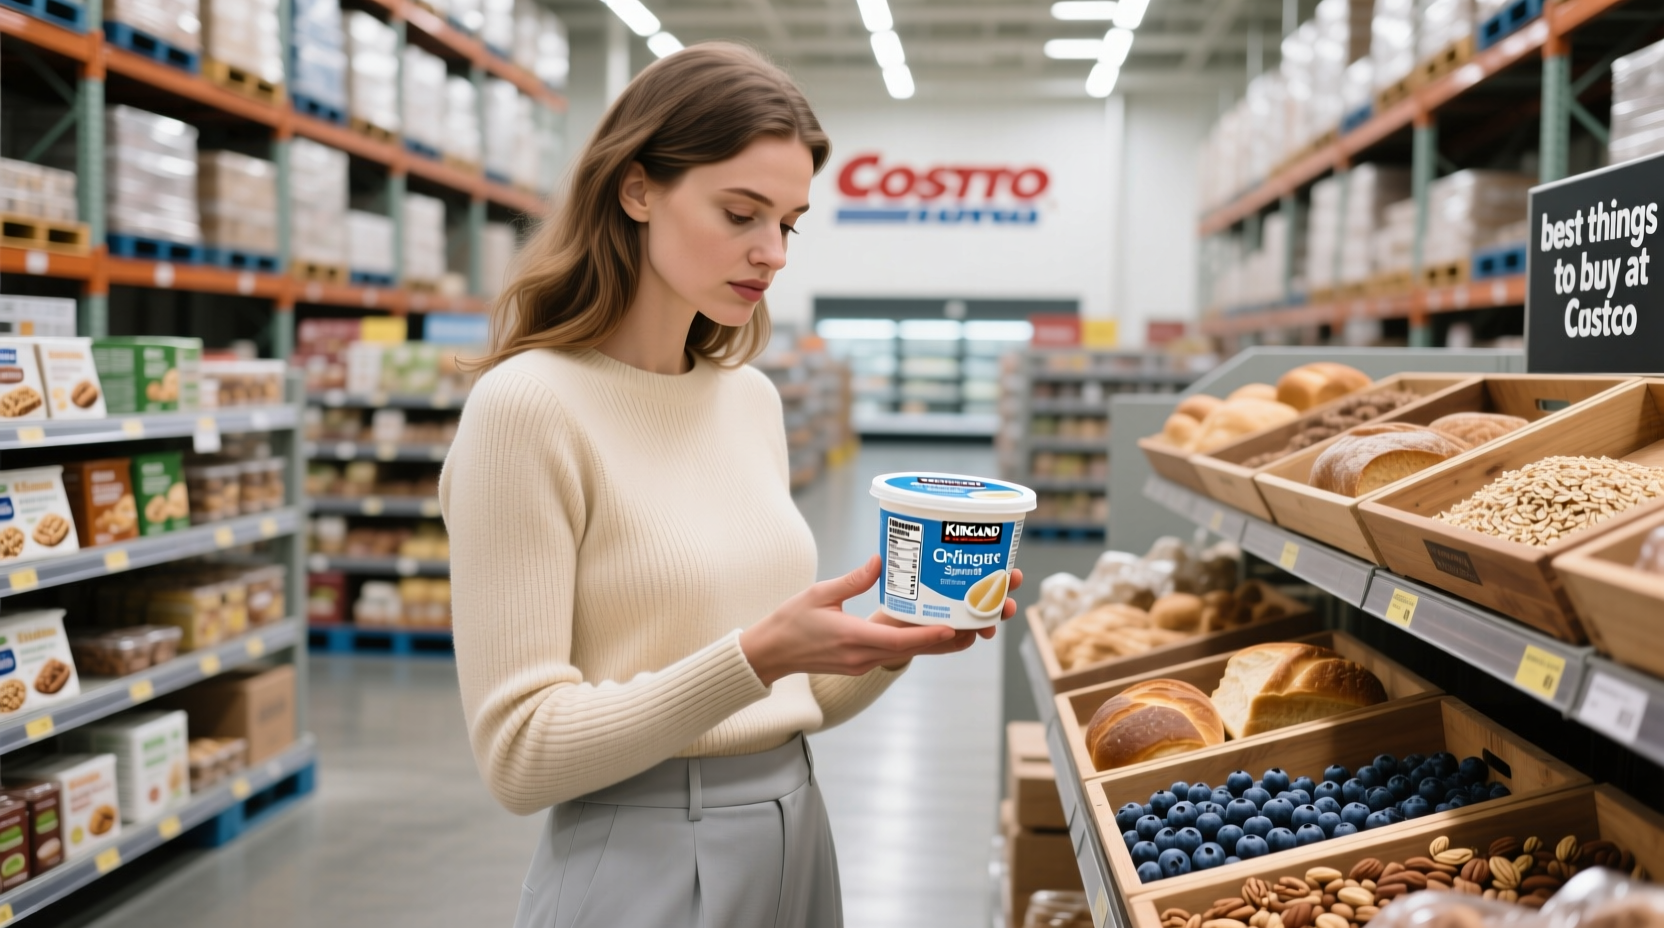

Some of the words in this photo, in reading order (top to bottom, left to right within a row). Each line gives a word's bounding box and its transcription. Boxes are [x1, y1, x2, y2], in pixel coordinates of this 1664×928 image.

[1541, 209, 1584, 252] best
[1587, 198, 1658, 248] things
[1554, 258, 1576, 295] to
[1580, 251, 1621, 298] buy
[1625, 247, 1650, 287] at
